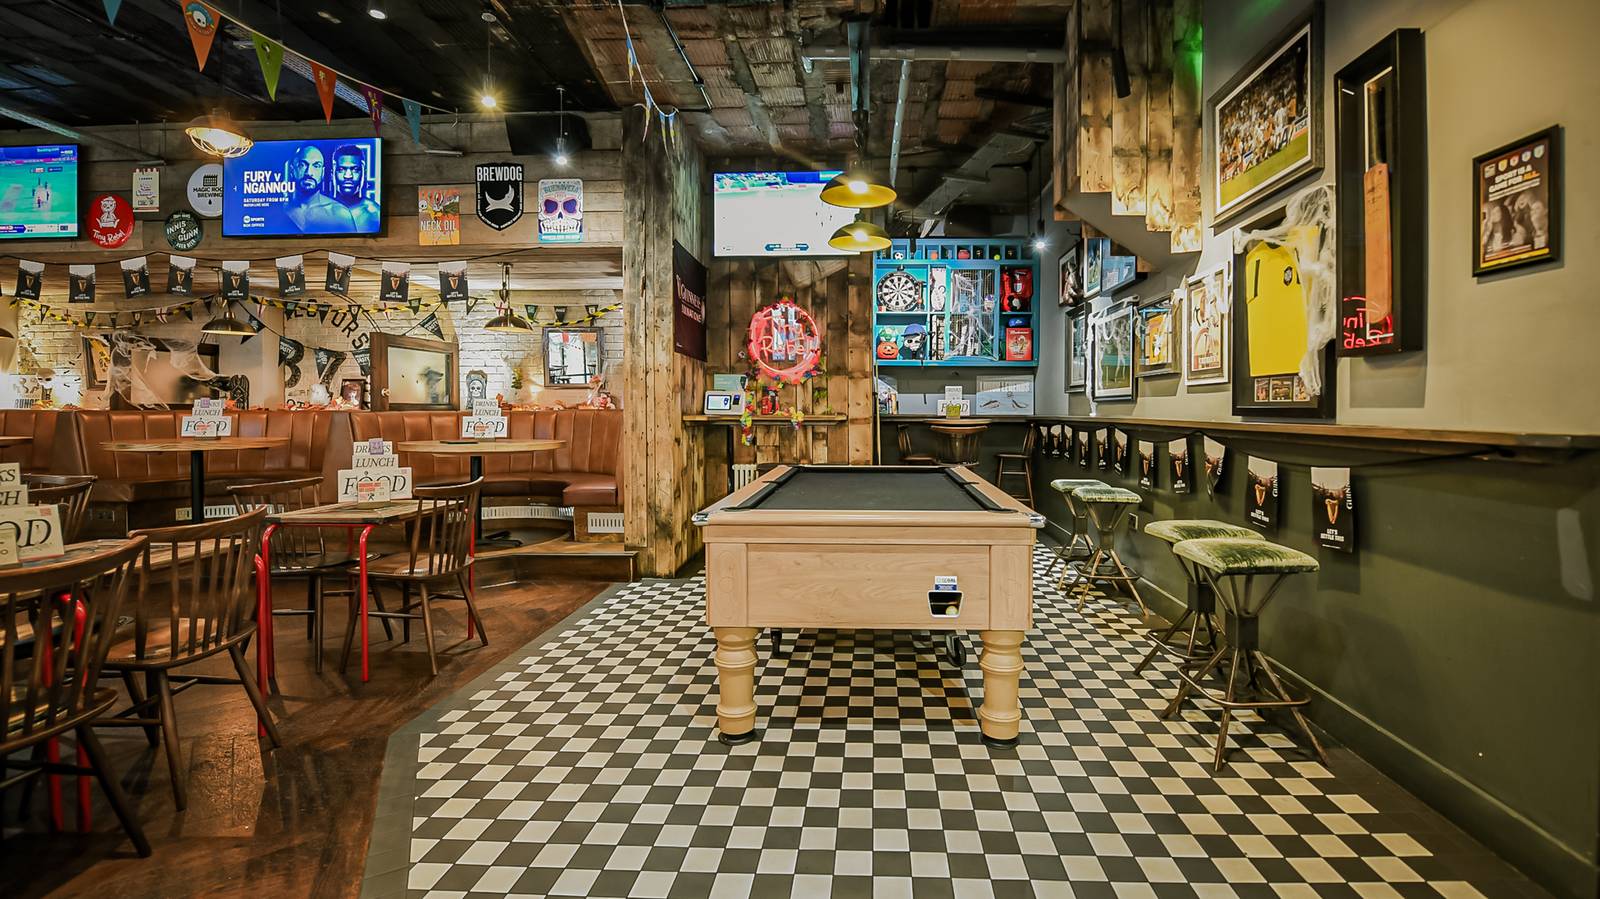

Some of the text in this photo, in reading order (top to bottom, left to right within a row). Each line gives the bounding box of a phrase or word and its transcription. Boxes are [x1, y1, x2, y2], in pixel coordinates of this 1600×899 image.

[243, 170, 272, 182] FURY
[476, 166, 523, 182] BREWDOG
[243, 182, 296, 194] NGANNOU
[166, 220, 187, 235] INNIS
[421, 220, 456, 231] NECK OIL
[92, 229, 125, 244] Tiny Rebel
[178, 227, 199, 242] GUNN
[355, 444, 391, 454] DRS
[355, 457, 395, 468] LUNCH
